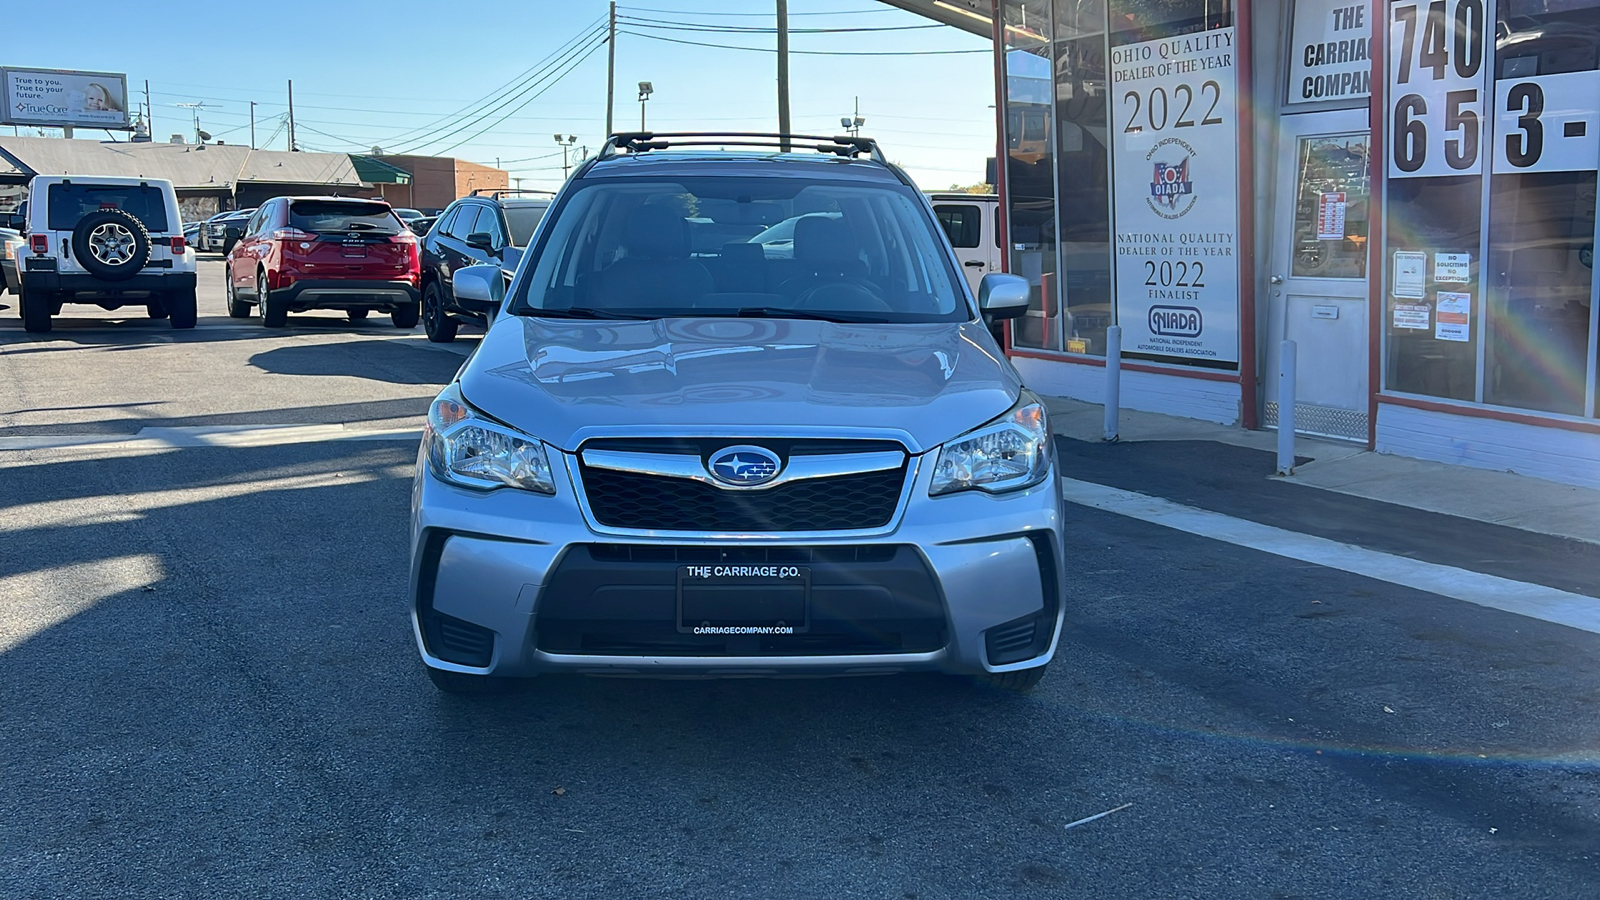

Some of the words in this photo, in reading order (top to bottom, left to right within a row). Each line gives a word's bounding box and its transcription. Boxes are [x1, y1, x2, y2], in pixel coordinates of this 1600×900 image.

[1332, 5, 1365, 31] THE
[1112, 45, 1152, 65] OHIO
[1159, 31, 1233, 59] QUALITY
[1395, 0, 1483, 84] 740
[1303, 37, 1372, 68] CARRIA
[1114, 65, 1155, 83] DEALER
[1157, 62, 1172, 77] OF
[1174, 59, 1198, 75] THE
[1200, 53, 1231, 71] YEAR
[24, 103, 68, 113] TrueCore
[1124, 80, 1222, 133] 2022
[1145, 144, 1159, 161] OHIO
[1157, 137, 1198, 158] INDEPENDENT
[1155, 182, 1186, 195] OIADA
[1117, 233, 1175, 243] NATIONAL
[1179, 233, 1233, 245] QUALITY
[1119, 246, 1156, 256] DEALER
[1160, 246, 1174, 256] OF
[1178, 247, 1198, 256] THE
[1203, 247, 1232, 256] YEAR
[1144, 260, 1205, 288] 2022
[1148, 289, 1200, 300] FINALIST
[1152, 311, 1198, 331] NIADA
[1137, 344, 1165, 353] AUTOMOBILE
[1165, 346, 1185, 354] DEALERS
[1185, 348, 1217, 357] ASSOCIATION
[1149, 337, 1172, 345] NATIONAL
[1171, 339, 1203, 348] INDEPENDENT
[687, 566, 712, 578] THE
[714, 566, 778, 577] CARRIAGE
[779, 566, 801, 578] CO.
[693, 626, 793, 635] CARRIAGECOMPANY.COM
